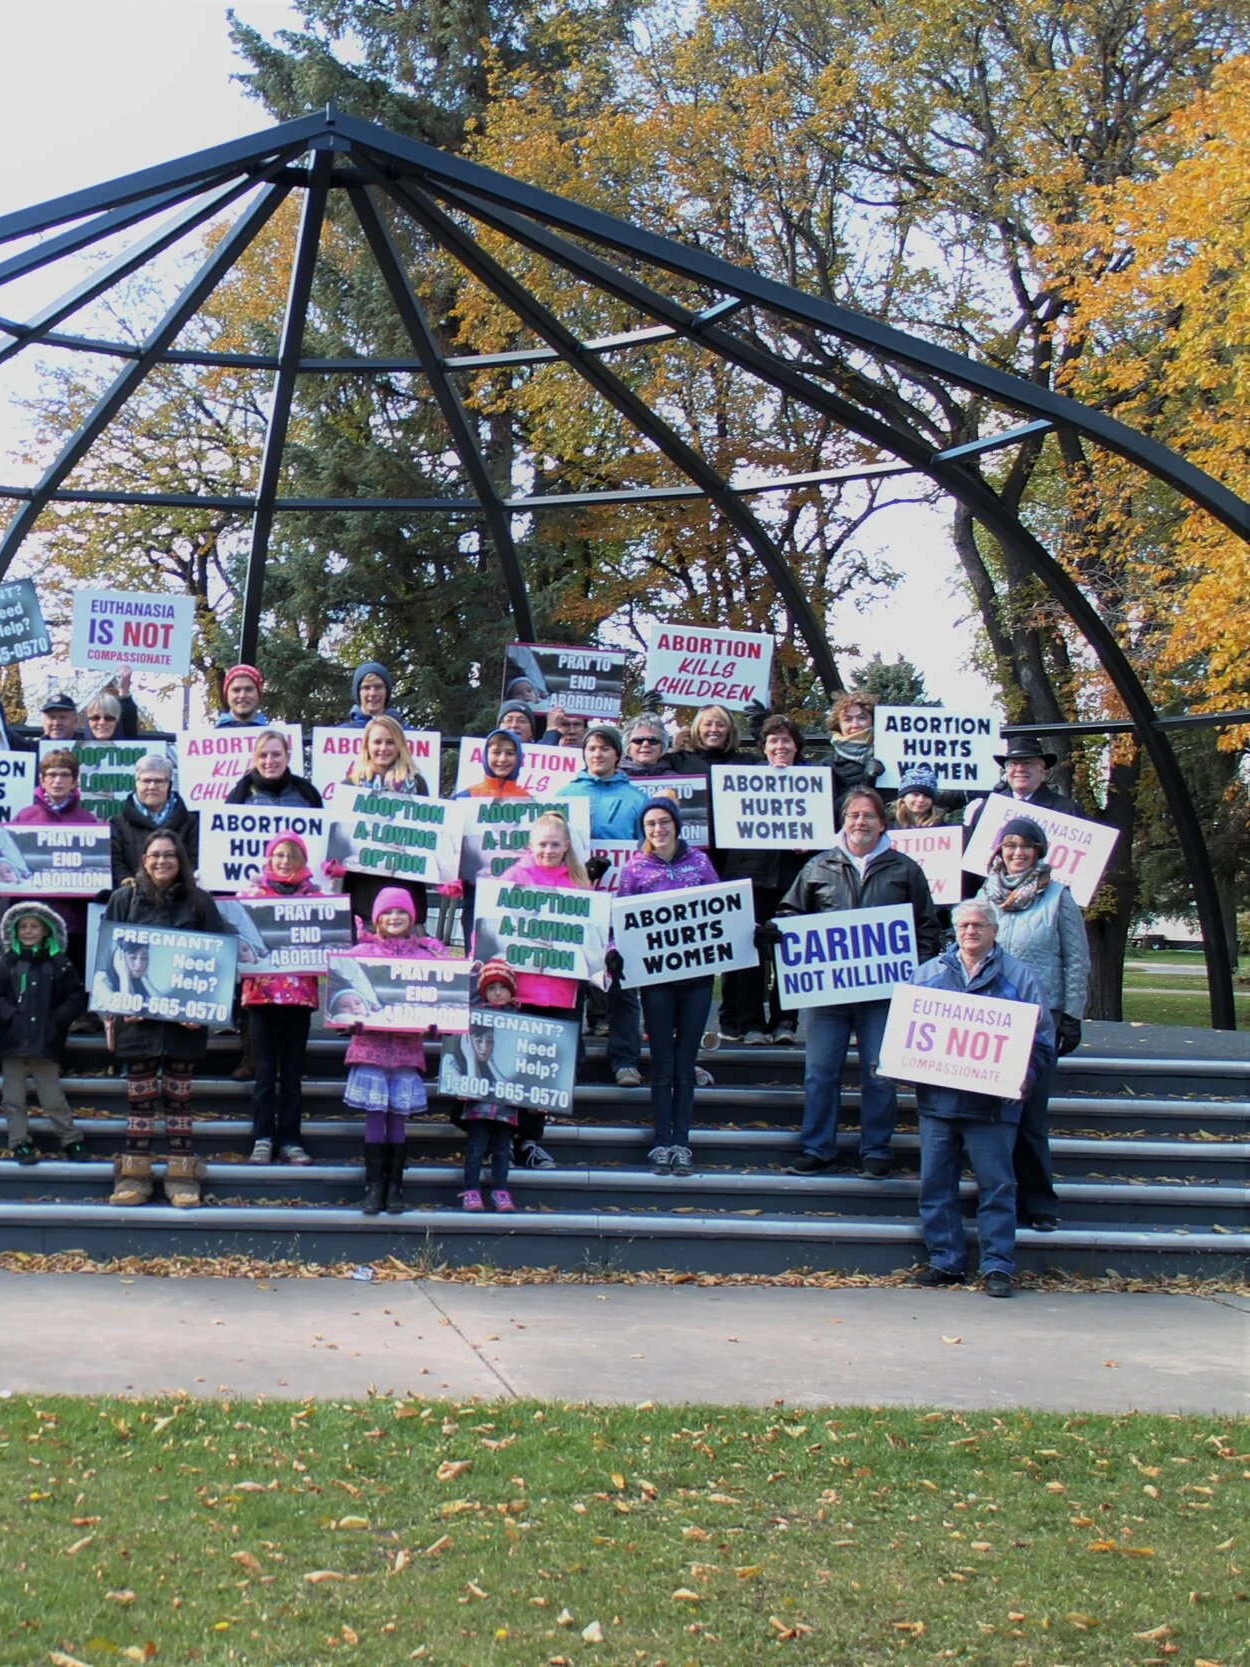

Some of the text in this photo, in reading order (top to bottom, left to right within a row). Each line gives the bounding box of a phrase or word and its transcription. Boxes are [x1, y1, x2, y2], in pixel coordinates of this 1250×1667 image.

[91, 599, 175, 619] EUTHANASIA
[88, 619, 174, 649] IS NOT
[657, 633, 761, 659] ABORTION
[87, 648, 172, 666] COMPASSIONATE
[558, 654, 611, 672] PRAY TO
[678, 657, 736, 679] KILLS
[570, 674, 596, 691] END
[654, 676, 756, 702] CHILDREN
[550, 692, 614, 713] ABORTION
[885, 715, 991, 736] ABORTION
[903, 738, 972, 757] HURTS
[719, 774, 824, 794] ABORTION
[352, 793, 446, 824] ADOPTION
[740, 798, 807, 817] HURTS
[210, 813, 322, 836] ABORTION
[736, 821, 814, 840] WOMEN
[37, 831, 96, 847] PRAY TO
[353, 821, 438, 850] A LOVING
[481, 830, 496, 850] A
[52, 851, 82, 868] END
[359, 847, 427, 875] OPTION
[32, 871, 104, 888] ABORTION
[274, 903, 335, 921] PRAY TO
[496, 887, 590, 918] ADOPTION
[624, 893, 742, 931] ABORTION
[112, 927, 224, 952] PREGNANT?
[290, 926, 321, 943] END
[499, 915, 584, 945] A LOVING
[646, 920, 724, 950] HURTS
[780, 919, 911, 967] CARING
[172, 953, 216, 973] Need
[506, 943, 575, 971] OPTION
[642, 941, 734, 975] WOMEN
[170, 973, 218, 994] Help?
[390, 964, 455, 982] PRAY TO
[783, 960, 913, 995] NOT KILLING
[405, 985, 438, 1002] END
[912, 998, 1012, 1029] EUTHANASIA
[516, 1037, 557, 1058] Need
[905, 1020, 1009, 1064] IS NOT
[515, 1058, 559, 1079] Help?
[900, 1055, 1002, 1083] COMPASSIONATE
